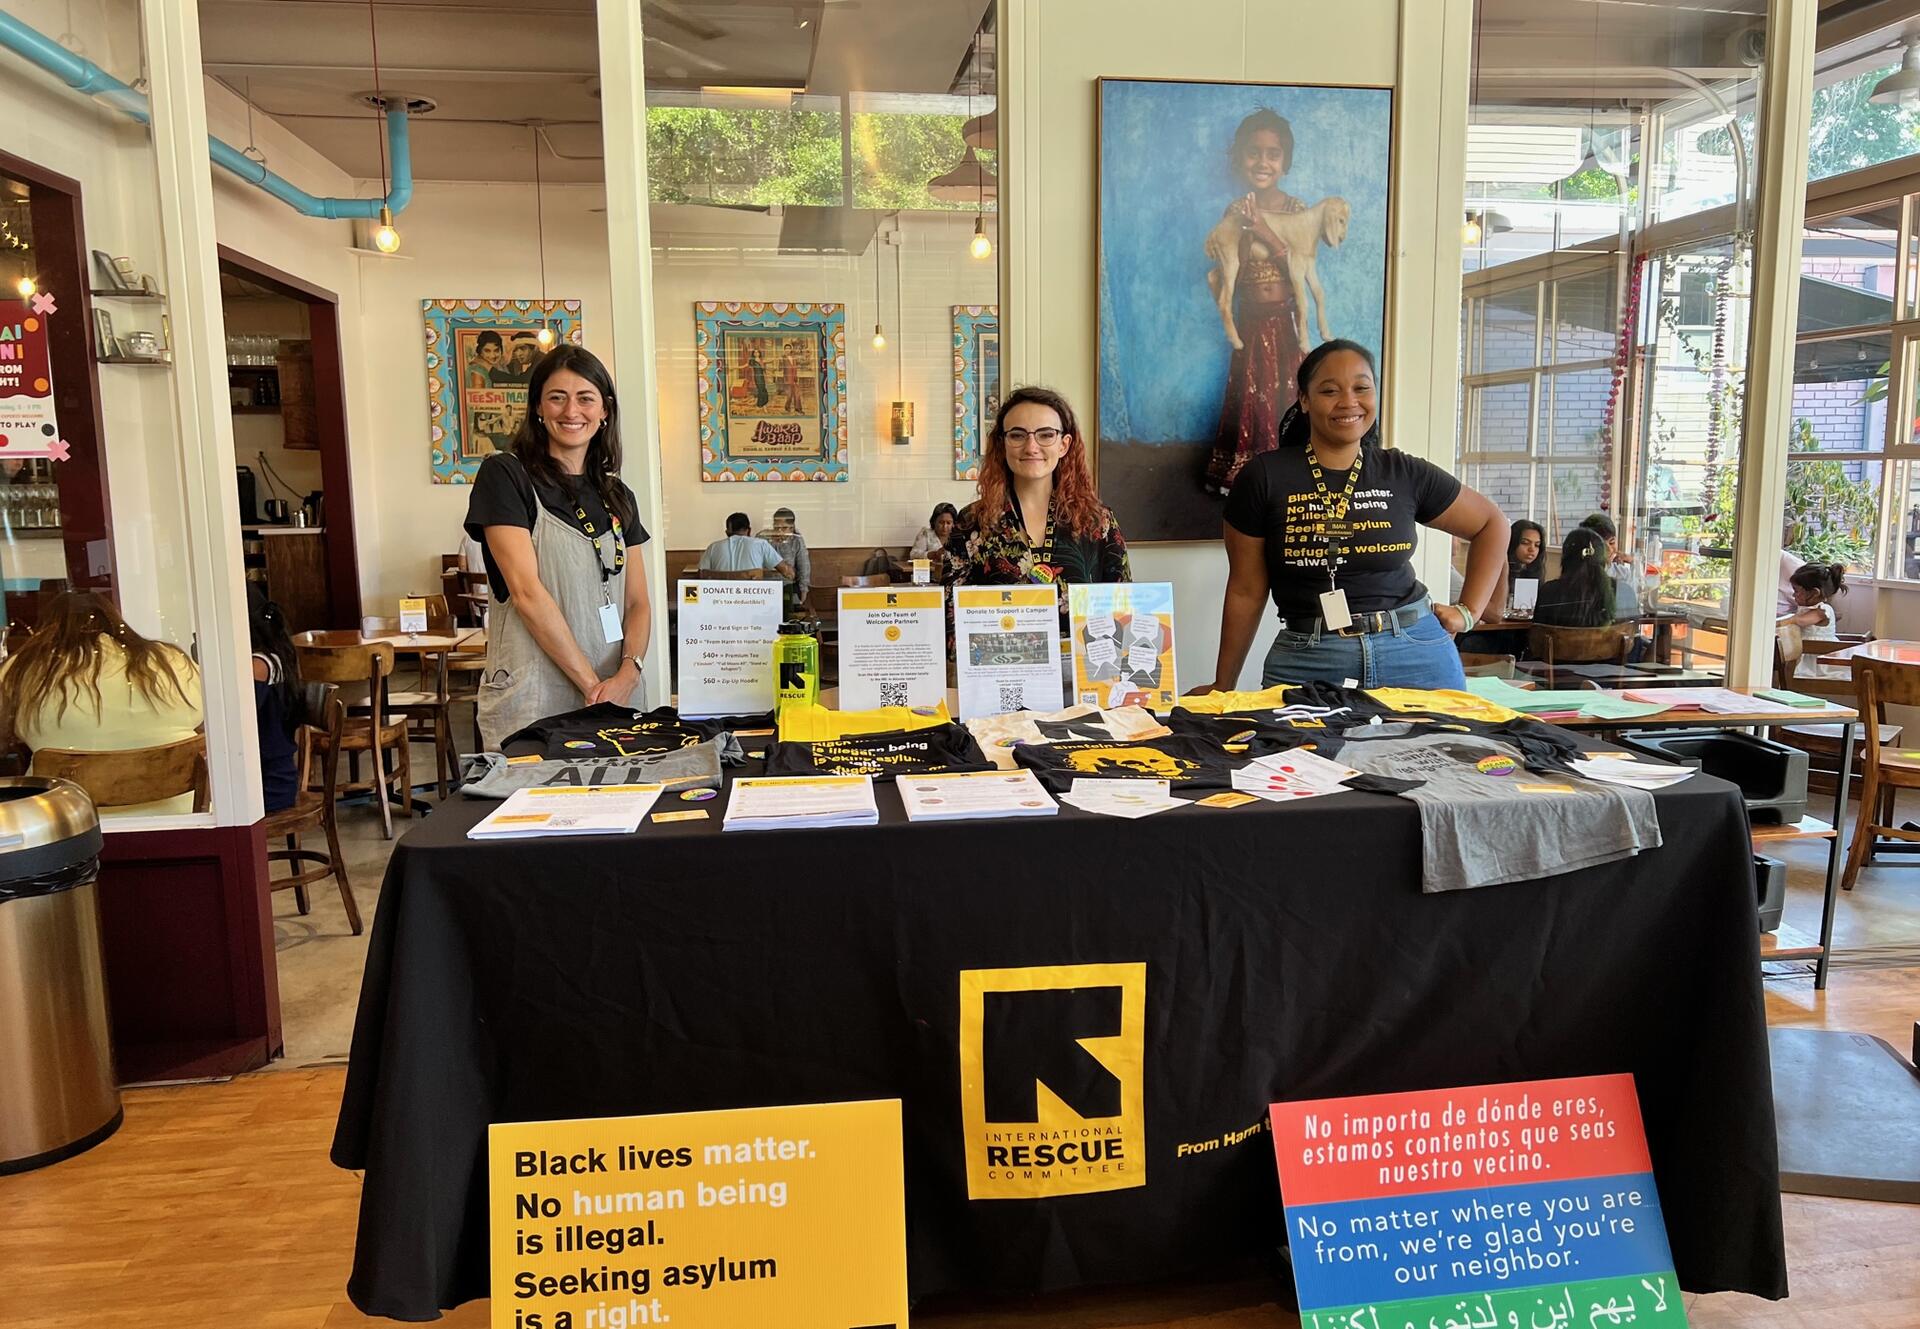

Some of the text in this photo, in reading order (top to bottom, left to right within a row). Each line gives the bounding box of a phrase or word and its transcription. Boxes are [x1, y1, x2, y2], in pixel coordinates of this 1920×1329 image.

[0, 324, 22, 341] AI
[0, 343, 24, 360] NI
[0, 364, 23, 374] ROM
[0, 376, 20, 387] HT!
[1287, 505, 1305, 515] No
[1353, 499, 1389, 511] being
[1354, 488, 1394, 499] matter.
[1352, 519, 1392, 531] sylum
[1354, 542, 1412, 554] welcome
[703, 587, 733, 595] DONATE
[735, 587, 741, 595] &
[702, 651, 719, 659] $40+
[888, 741, 928, 751] being
[542, 766, 653, 786] ALL
[1304, 1093, 1605, 1140] No importa de dónde eres,
[985, 1126, 1123, 1142] INTERNATIONAL
[1177, 1138, 1219, 1158] From
[1223, 1122, 1261, 1147] Harm
[1303, 1120, 1616, 1166] estamos contentos que seas
[515, 1136, 816, 1177] Black lives matter.
[987, 1138, 1125, 1167] RESCUE
[1379, 1149, 1551, 1185] nuestro vecino.
[988, 1162, 1125, 1179] COMMITTEE
[516, 1178, 787, 1220] No human being
[1298, 1190, 1642, 1240] No matter where you are
[516, 1220, 665, 1256] is illegal.
[1315, 1213, 1635, 1265] from, we're glad you're
[514, 1256, 777, 1299] Seeking asylum
[1394, 1246, 1580, 1284] our neighbor.
[1641, 1276, 1667, 1312] لا
[515, 1298, 670, 1329] is a right.
[1589, 1293, 1637, 1329] يهم
